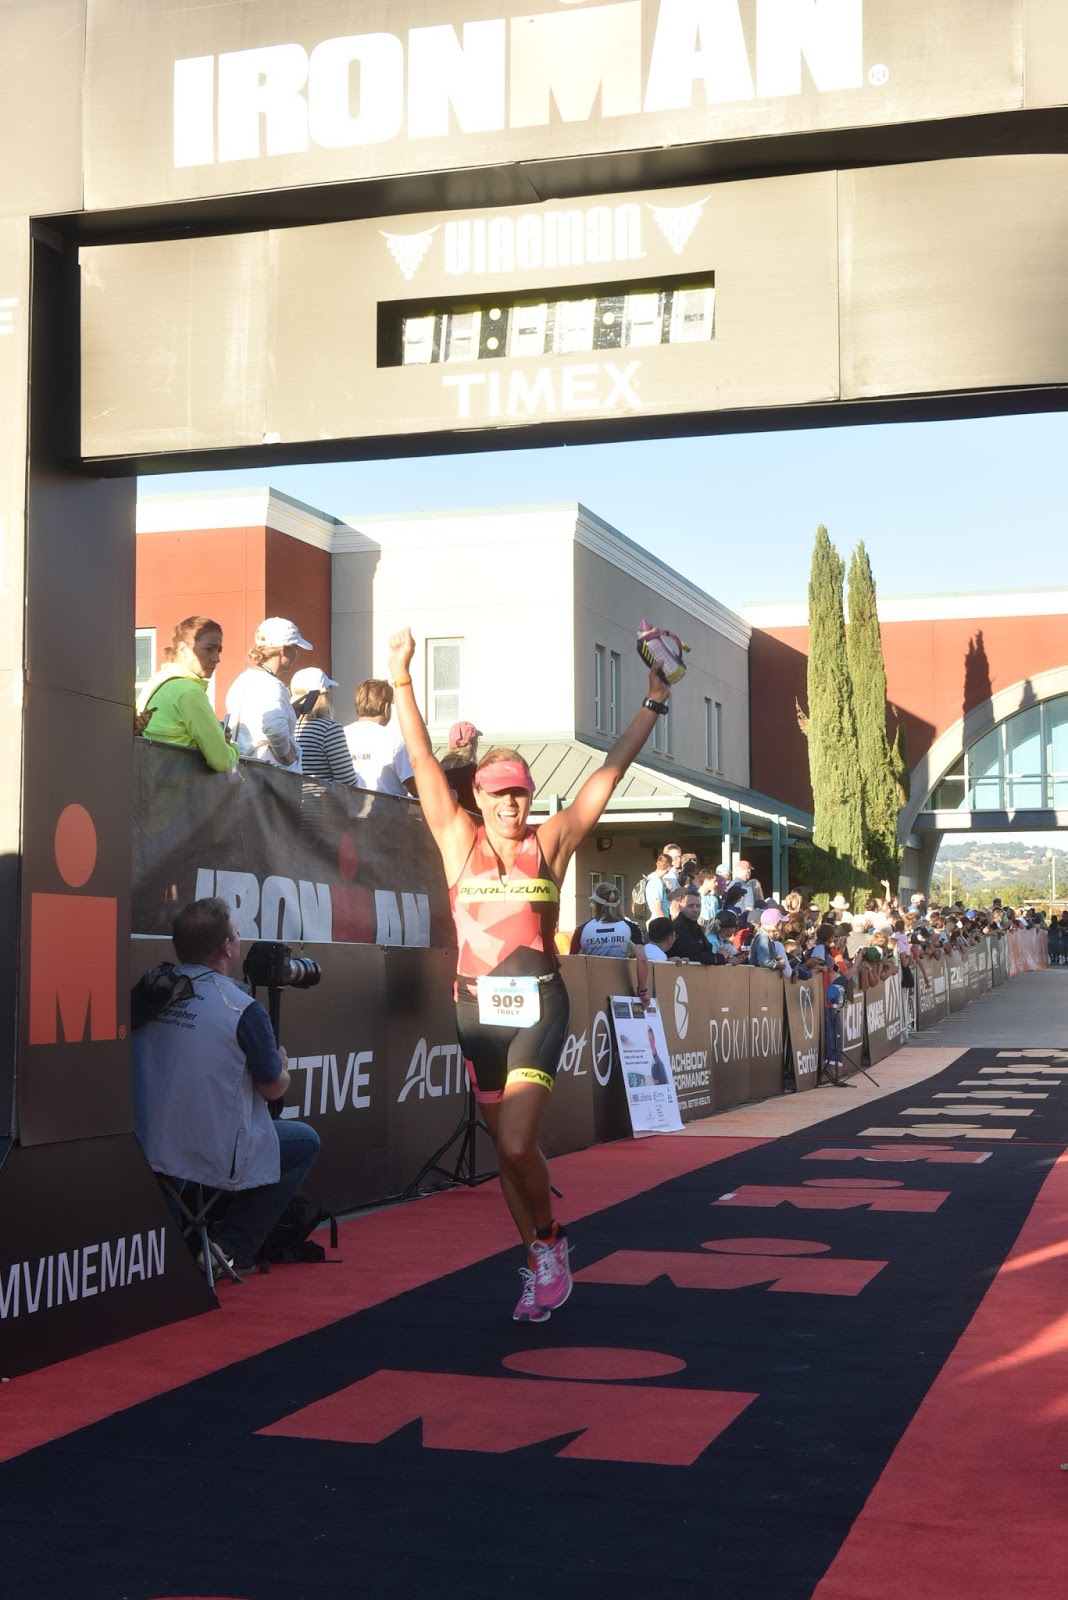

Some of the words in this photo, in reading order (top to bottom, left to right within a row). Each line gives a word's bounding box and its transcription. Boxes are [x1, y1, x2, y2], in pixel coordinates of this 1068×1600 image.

[173, 0, 864, 168] IRONMAN
[442, 360, 641, 418] TIMEX
[460, 887, 505, 895] PEARL
[492, 995, 524, 1008] 909
[397, 1037, 470, 1103] ACTI
[671, 1051, 707, 1073] ACHBODY
[674, 1070, 710, 1090] FORMANCE
[279, 1051, 373, 1120] CTIVE
